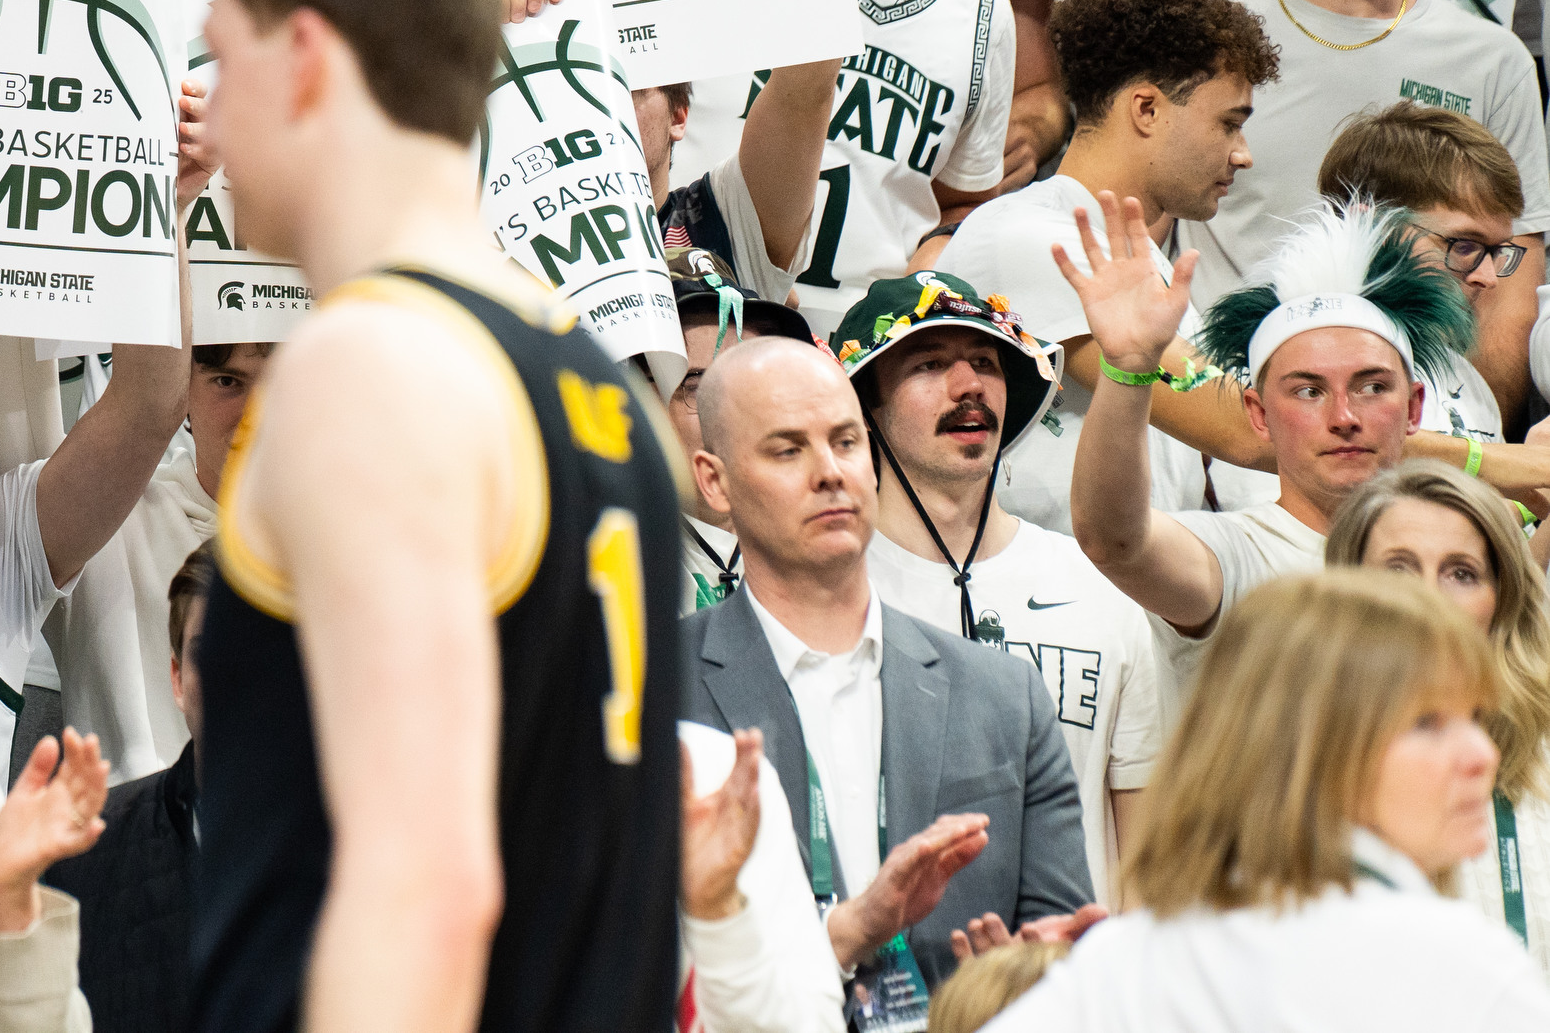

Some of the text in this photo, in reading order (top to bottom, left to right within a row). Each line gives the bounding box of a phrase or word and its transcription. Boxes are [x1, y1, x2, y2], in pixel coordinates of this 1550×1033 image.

[92, 88, 114, 105] 25
[1399, 78, 1472, 117] MICHIGAN STATE
[490, 173, 511, 196] 20
[50, 272, 96, 292] STATE
[588, 507, 648, 765] 1
